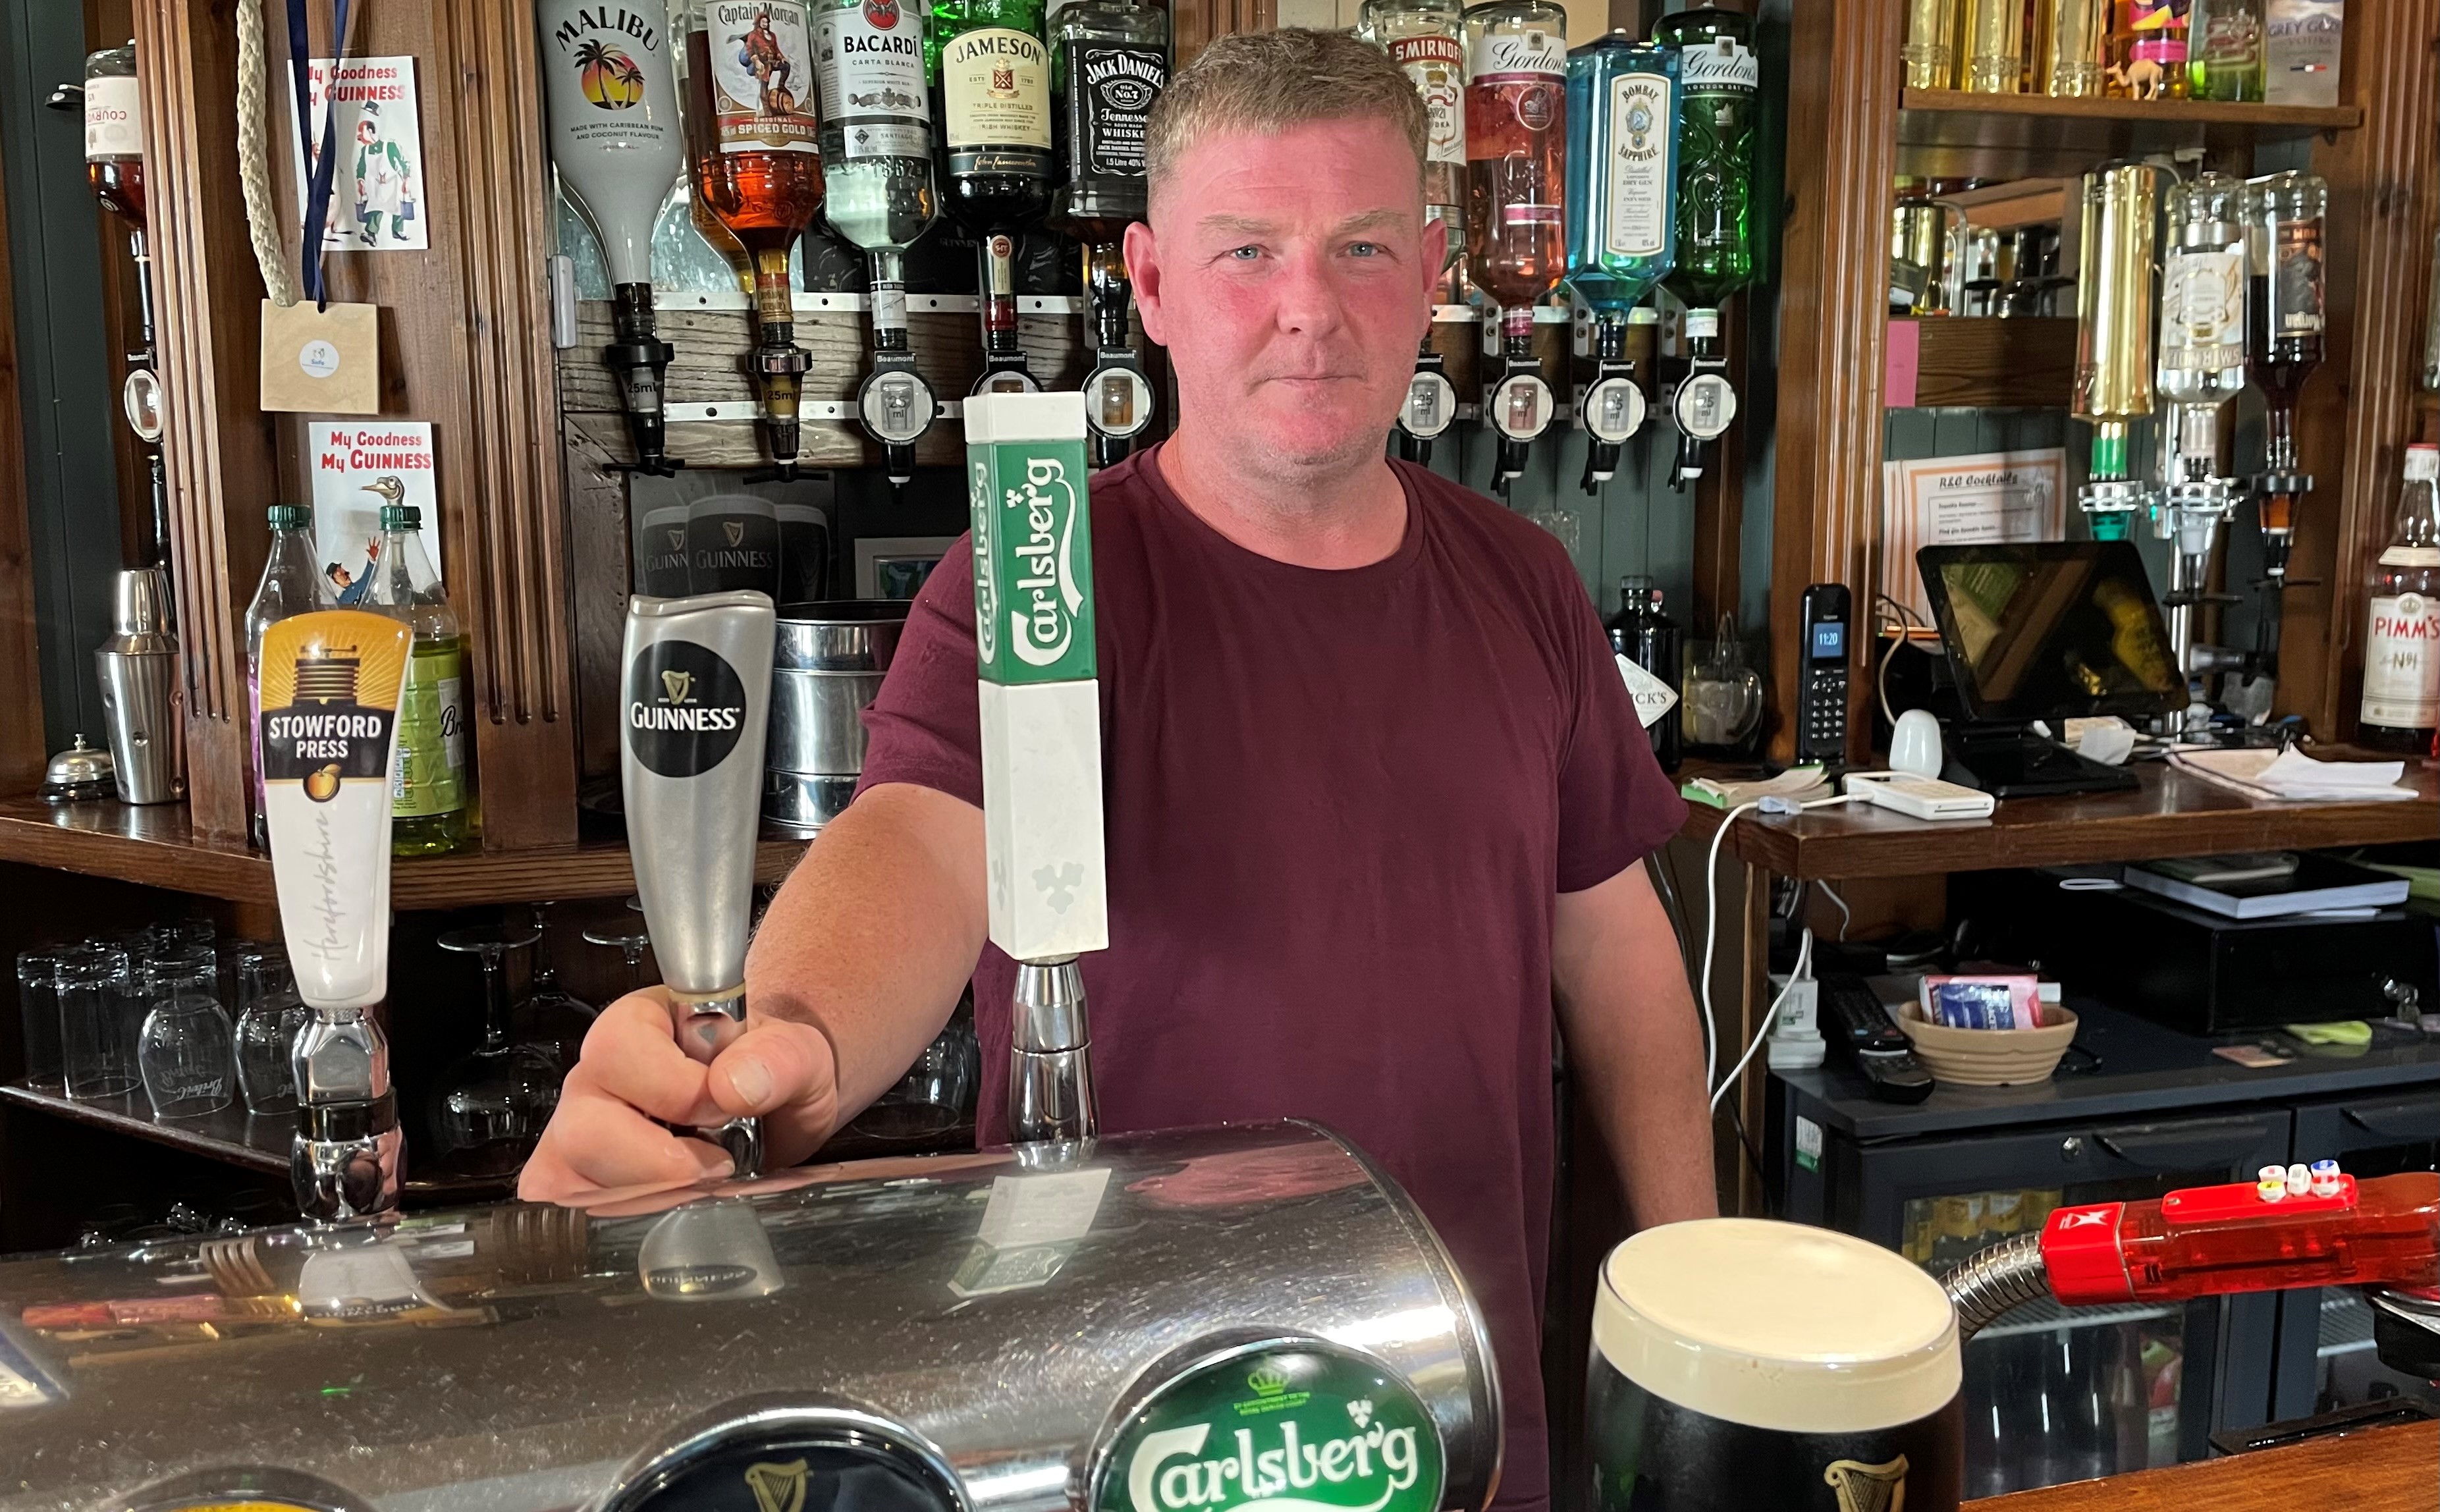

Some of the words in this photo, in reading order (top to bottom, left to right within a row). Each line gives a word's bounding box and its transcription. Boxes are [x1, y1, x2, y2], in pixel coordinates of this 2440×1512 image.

[718, 2, 760, 26] Captain
[760, 2, 800, 27] Morgan
[556, 6, 659, 51] MALIBU
[956, 37, 1041, 65] JAMESON
[330, 65, 397, 80] Goodness
[1085, 59, 1118, 84] JACK
[1118, 54, 1164, 89] DANIEL'S
[325, 84, 406, 101] GUINNESS
[1115, 90, 1139, 99] No.7
[1622, 84, 1660, 103] BOMBAY
[1100, 108, 1149, 123] Tennesse
[738, 124, 780, 134] SPICED
[782, 124, 806, 135] GOLD
[1102, 128, 1147, 138] WHISKE
[1618, 143, 1660, 161] SAPPHIRE
[627, 383, 656, 394] 25ml
[767, 390, 796, 401] 25ml
[331, 431, 351, 449] My
[357, 431, 422, 446] Goodness
[321, 453, 344, 473] My
[350, 449, 432, 470] GUINNESS
[646, 553, 689, 572] GUINN
[695, 549, 773, 569] GUINNESS
[974, 462, 998, 664] Carlsberg
[1012, 457, 1077, 666] Carlsberg
[2375, 615, 2440, 638] PIMM'S
[1819, 632, 1838, 645] 11:20
[630, 701, 737, 731] GUINNESS
[269, 715, 383, 739] STOWFORD
[296, 740, 349, 759] PRESS
[1128, 1420, 1420, 1512] Carlsberg
